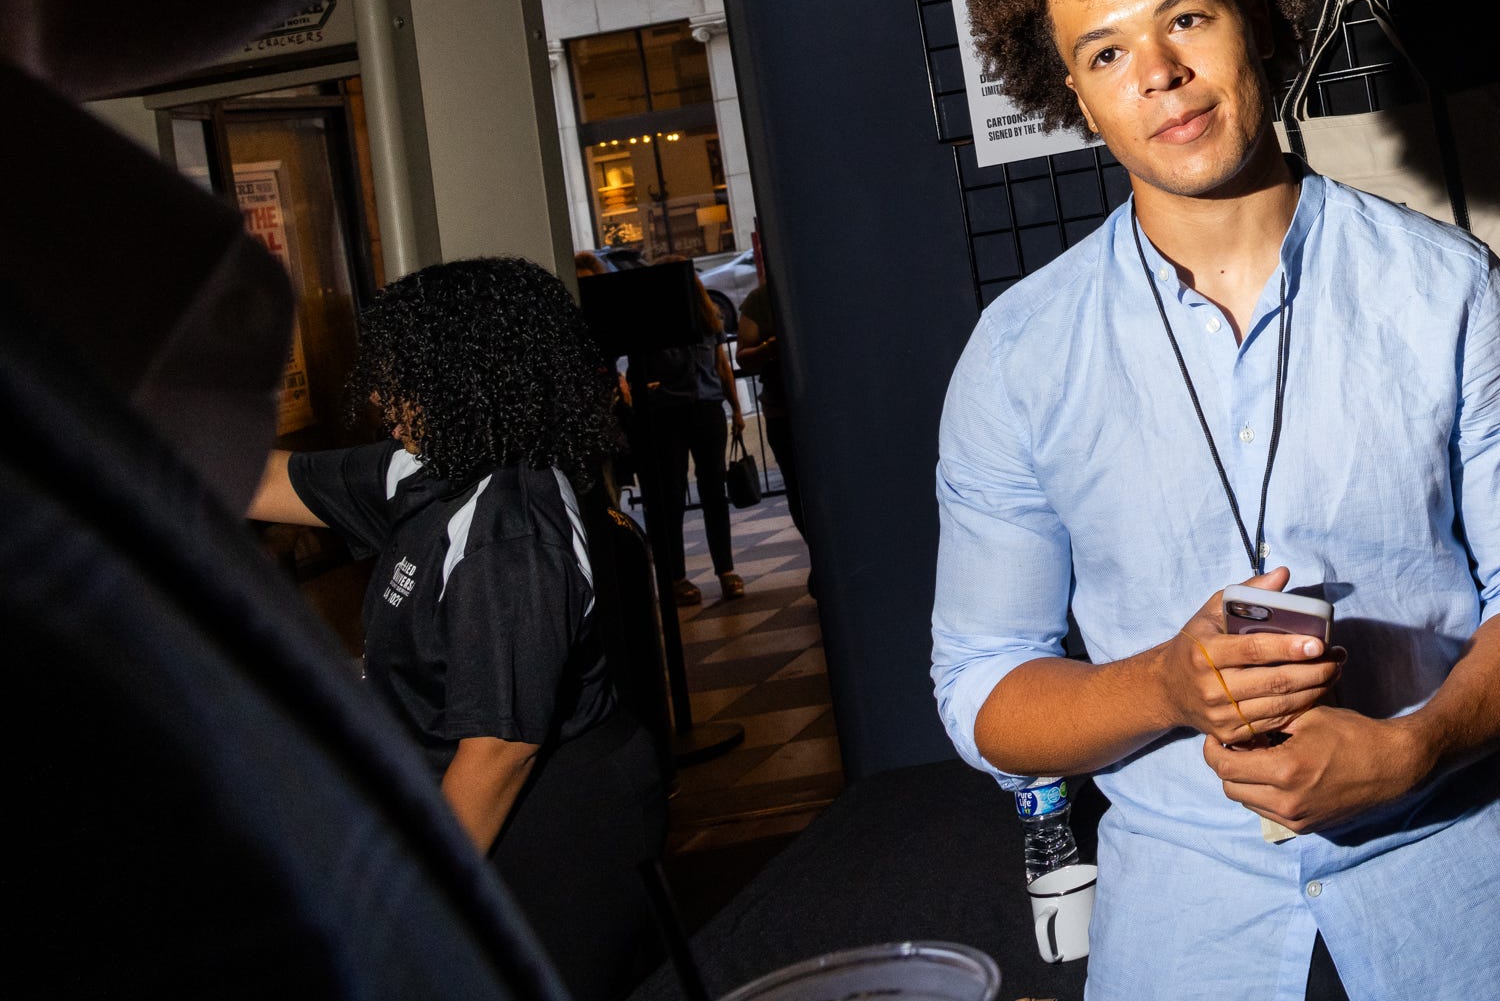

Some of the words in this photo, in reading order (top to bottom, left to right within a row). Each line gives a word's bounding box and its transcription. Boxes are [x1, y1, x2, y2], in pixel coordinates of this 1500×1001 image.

[258, 31, 324, 50] CRACKERS
[986, 113, 1028, 129] CARTOONS
[988, 128, 1013, 142] SIGNED
[1014, 126, 1022, 137] BY
[1024, 124, 1036, 135] THE
[244, 205, 278, 231] THE
[1017, 792, 1033, 800] Pure
[1019, 798, 1032, 808] Life
